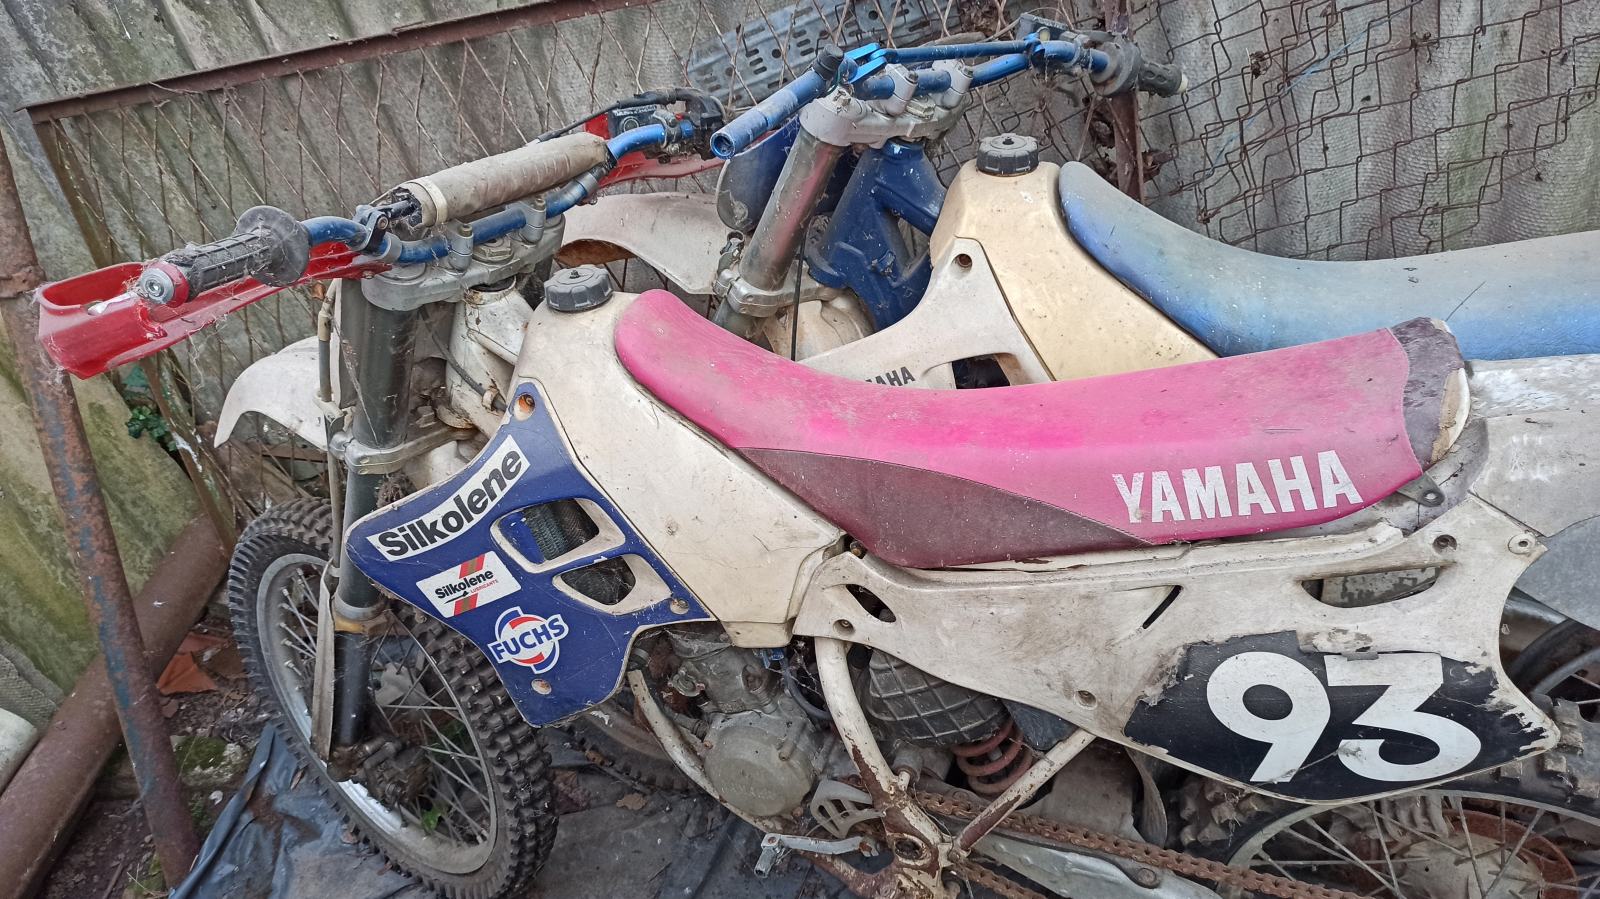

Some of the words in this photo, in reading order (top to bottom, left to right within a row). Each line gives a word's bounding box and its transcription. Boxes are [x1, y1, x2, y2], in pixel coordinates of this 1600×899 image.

[378, 451, 522, 557] Silkolene
[1112, 450, 1363, 524] YAMAHA
[435, 570, 494, 599] Silkolene
[491, 618, 565, 660] FUCHS
[1207, 651, 1481, 783] 93
